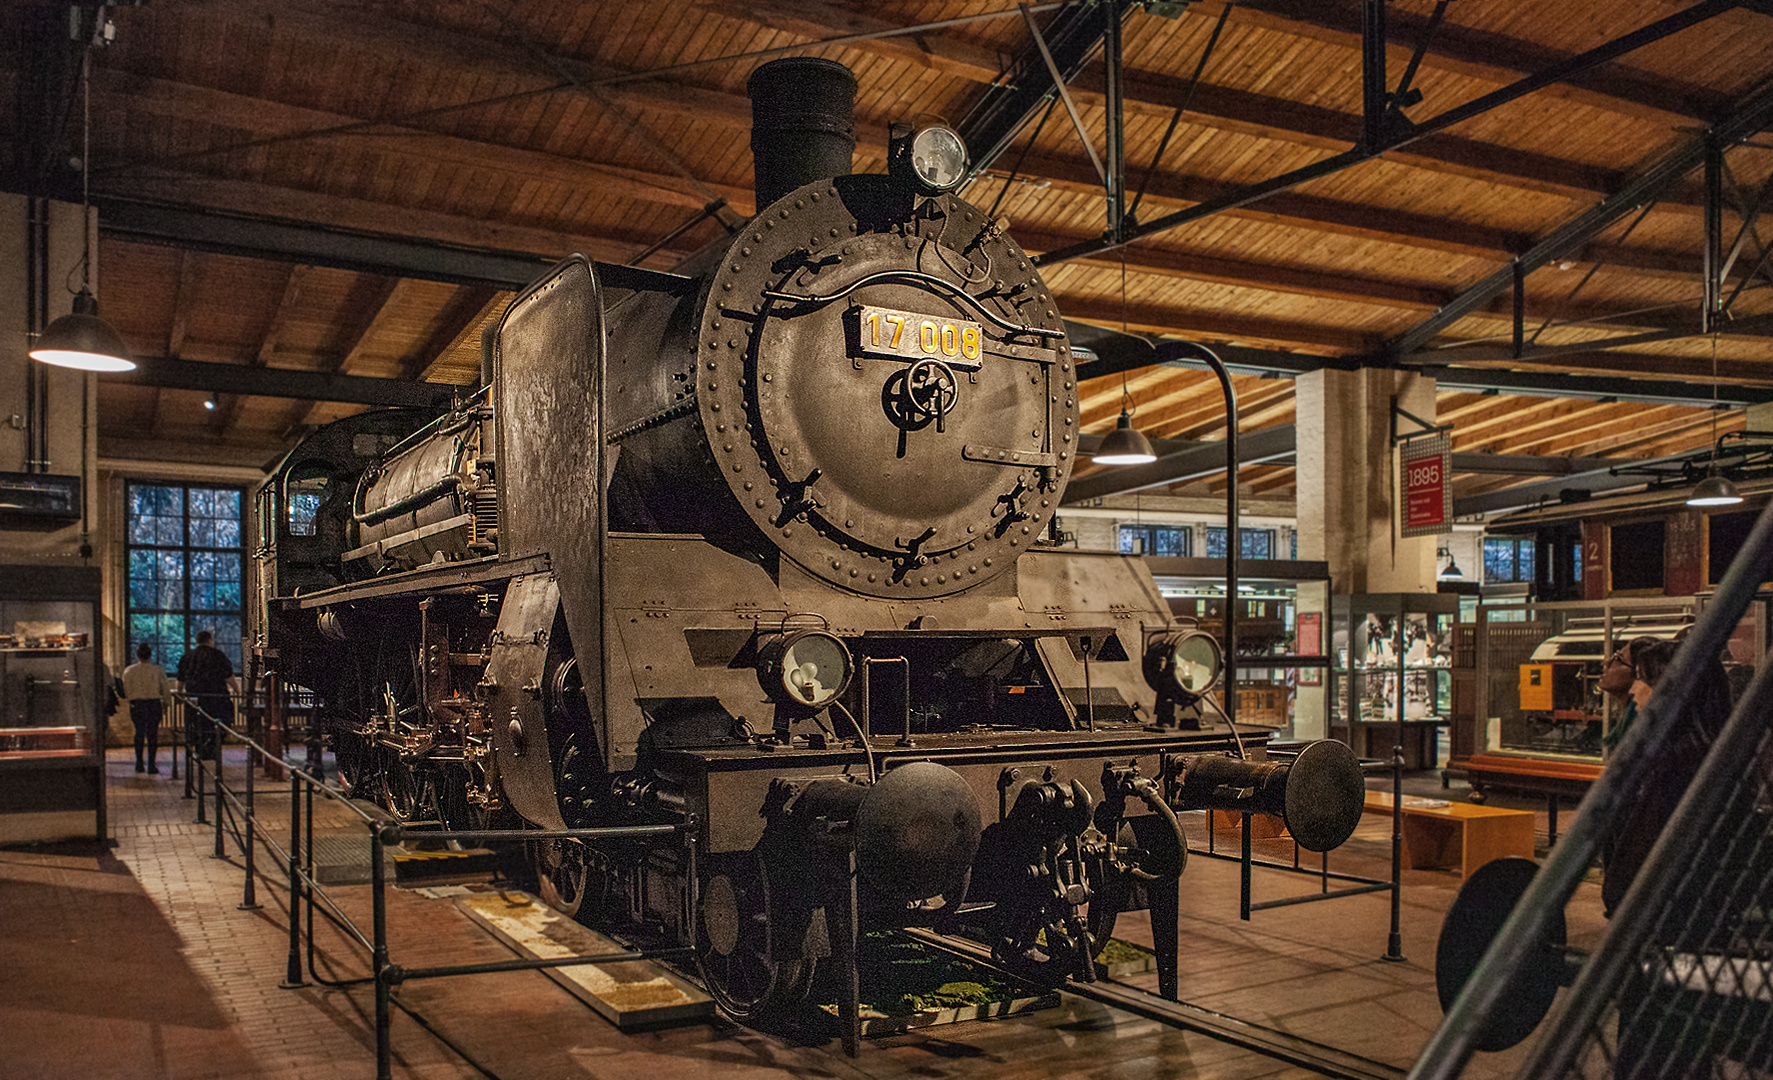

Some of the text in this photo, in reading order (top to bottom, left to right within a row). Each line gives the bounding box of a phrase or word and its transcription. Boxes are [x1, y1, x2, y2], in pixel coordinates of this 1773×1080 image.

[866, 312, 979, 360] 17 008
[1409, 465, 1439, 487] 1895
[1589, 542, 1599, 560] 2
